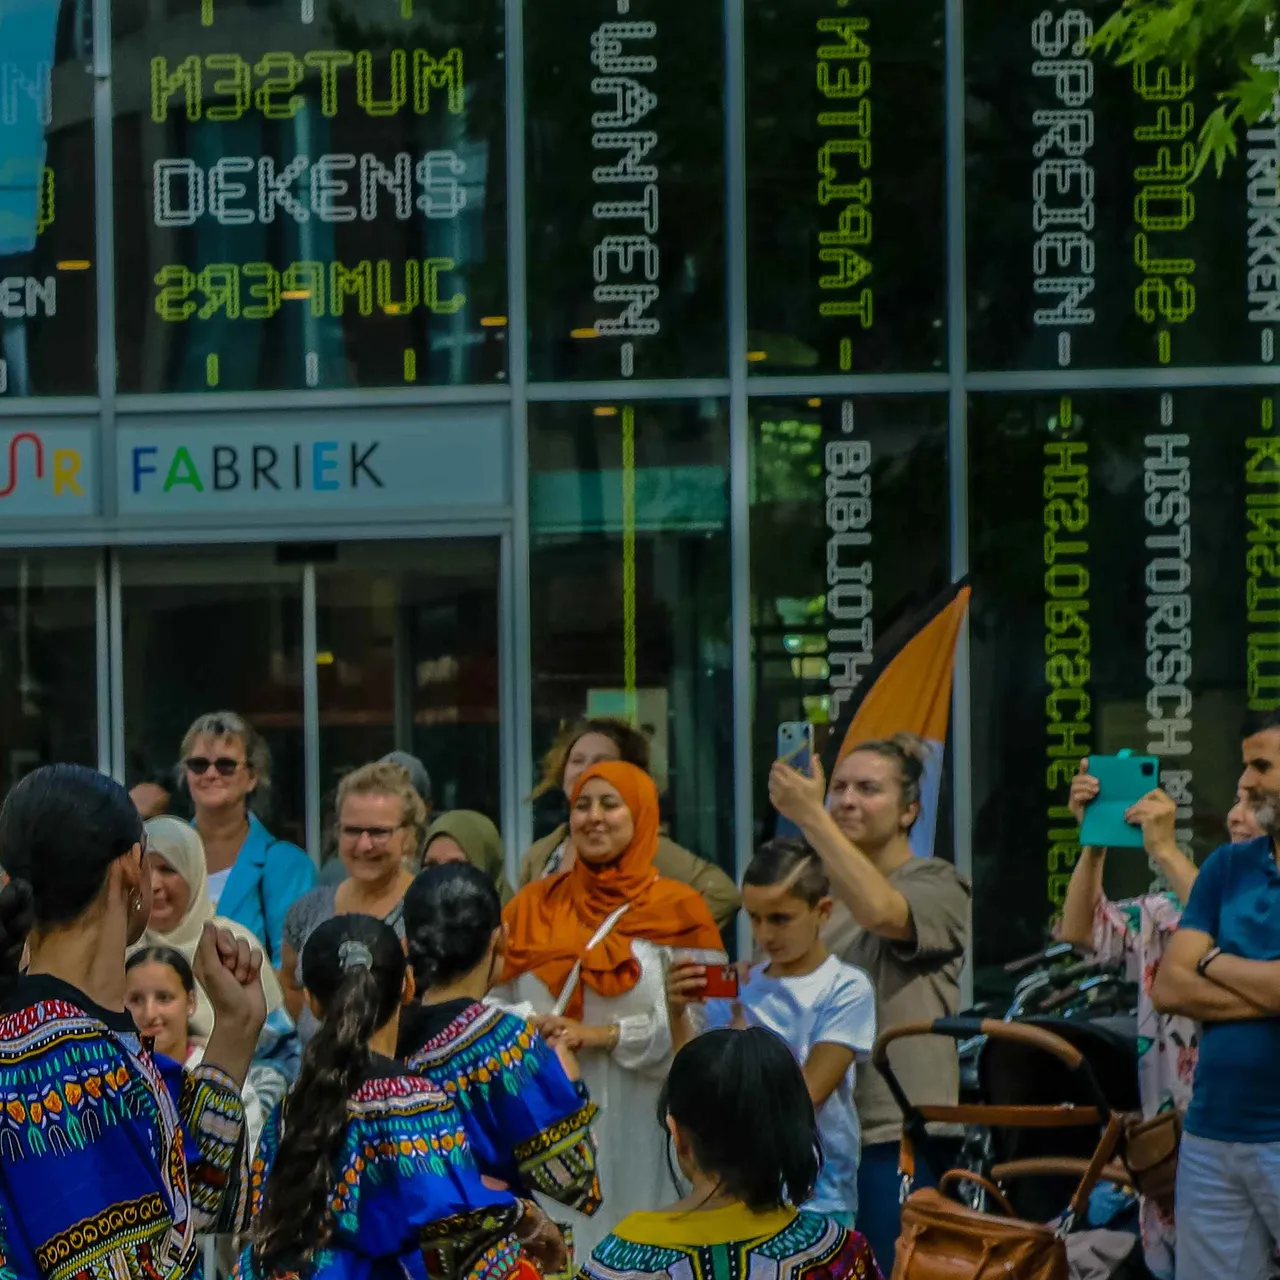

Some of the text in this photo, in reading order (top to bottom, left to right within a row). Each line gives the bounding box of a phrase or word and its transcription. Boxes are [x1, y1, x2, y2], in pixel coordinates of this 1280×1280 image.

[153, 150, 466, 226] DEKENS
[590, 21, 659, 337] WANTEN
[1032, 9, 1095, 324] SPREIEN
[132, 441, 384, 493] FABRIEK
[1145, 434, 1193, 755] HISTORISCH
